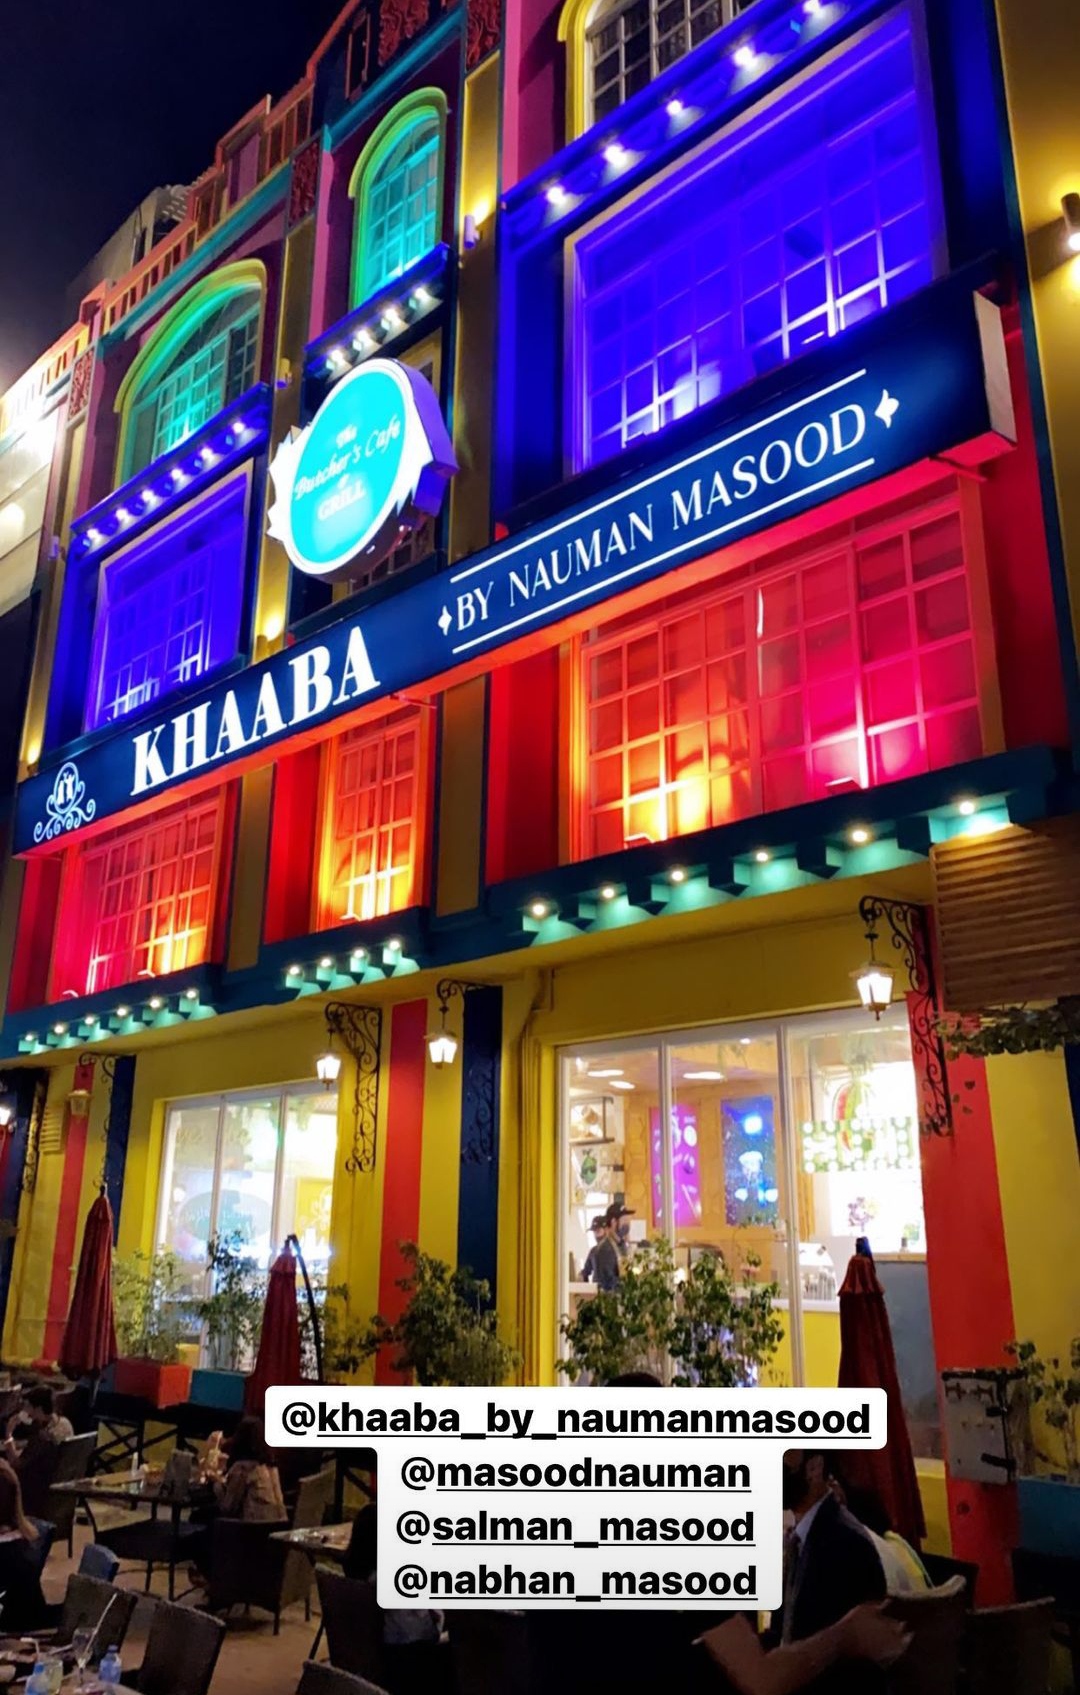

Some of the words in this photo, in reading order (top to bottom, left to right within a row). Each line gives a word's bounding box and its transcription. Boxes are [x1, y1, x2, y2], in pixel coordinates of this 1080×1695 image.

[456, 581, 494, 631] BY
[509, 504, 654, 607] NAUMAN
[672, 403, 866, 531] MASOOD
[130, 626, 381, 796] KHAABA
